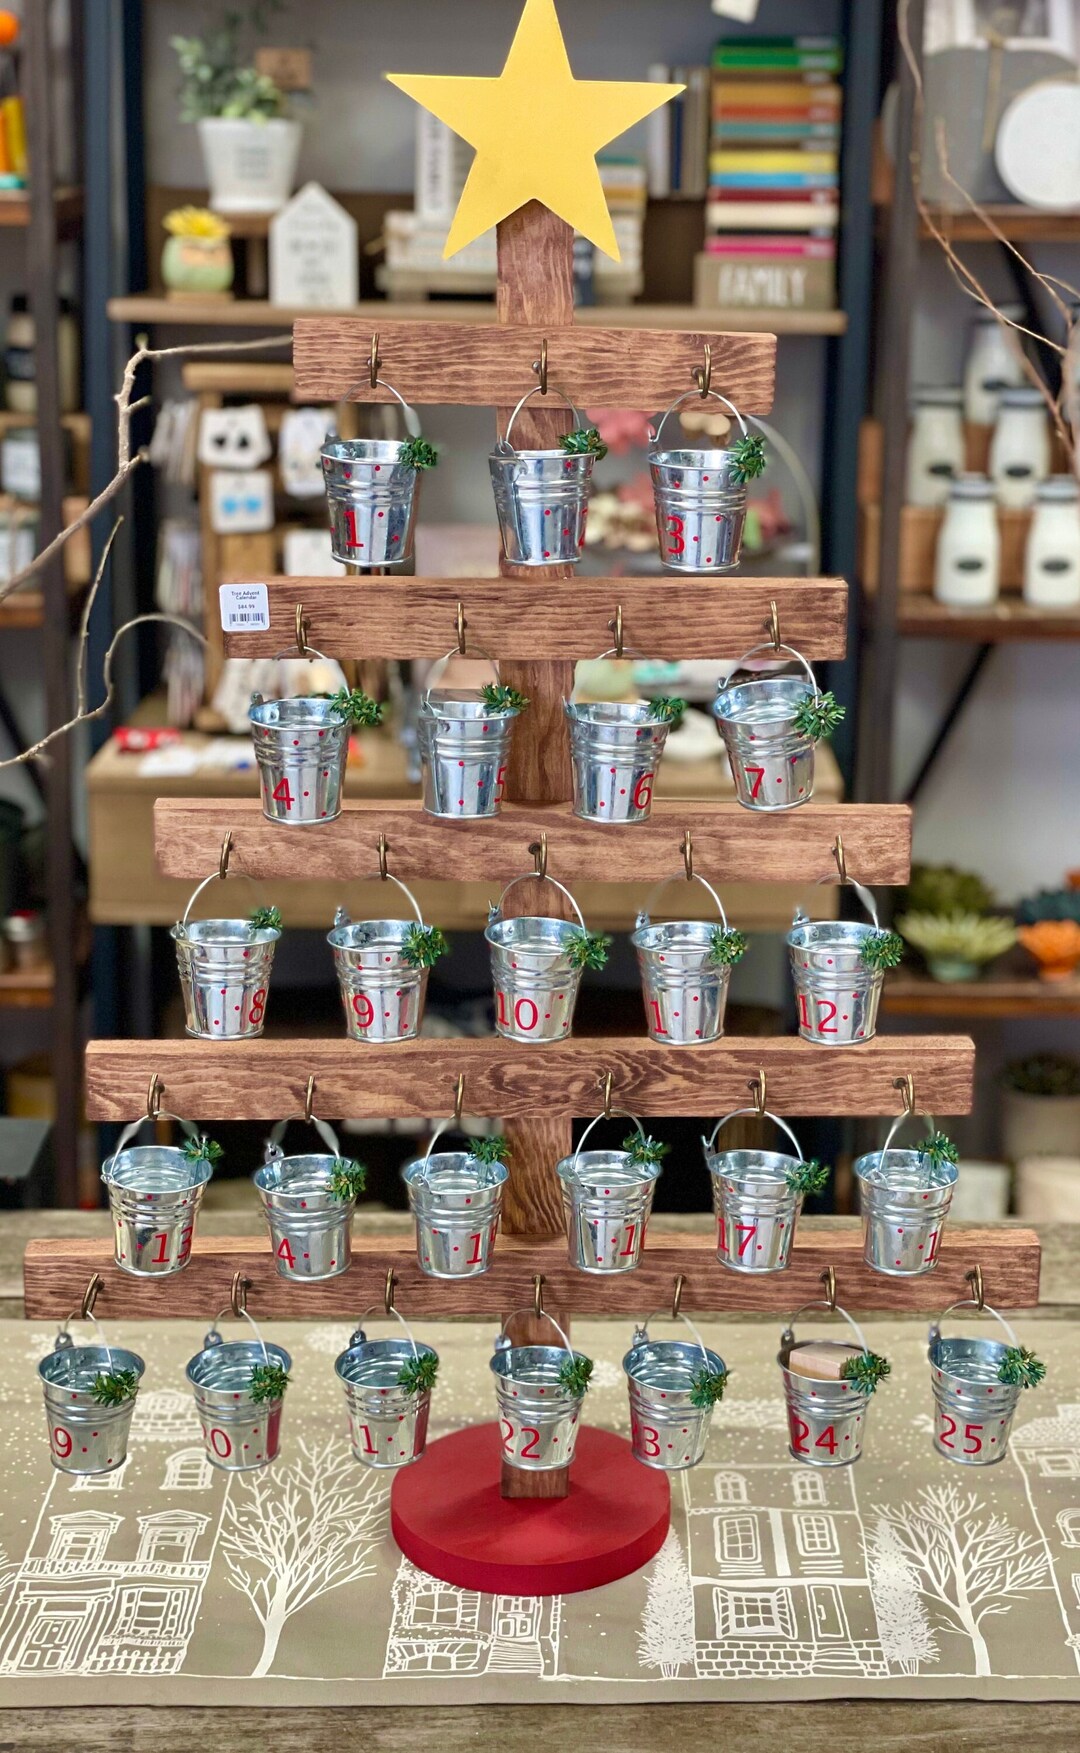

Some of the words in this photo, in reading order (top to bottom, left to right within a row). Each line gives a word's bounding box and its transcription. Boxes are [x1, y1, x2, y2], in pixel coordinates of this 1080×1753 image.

[719, 264, 806, 306] FAMILY
[343, 509, 364, 548] 1
[666, 515, 685, 554] 3
[272, 777, 295, 810] 4
[633, 773, 654, 810] 6
[744, 767, 765, 798] 7
[248, 987, 266, 1024] 8
[352, 993, 375, 1028] 9
[496, 991, 540, 1031] 10
[799, 994, 838, 1033] 12
[718, 1217, 757, 1257] 17
[501, 1418, 541, 1459] 22
[793, 1418, 839, 1455] 24
[939, 1413, 984, 1454] 25
